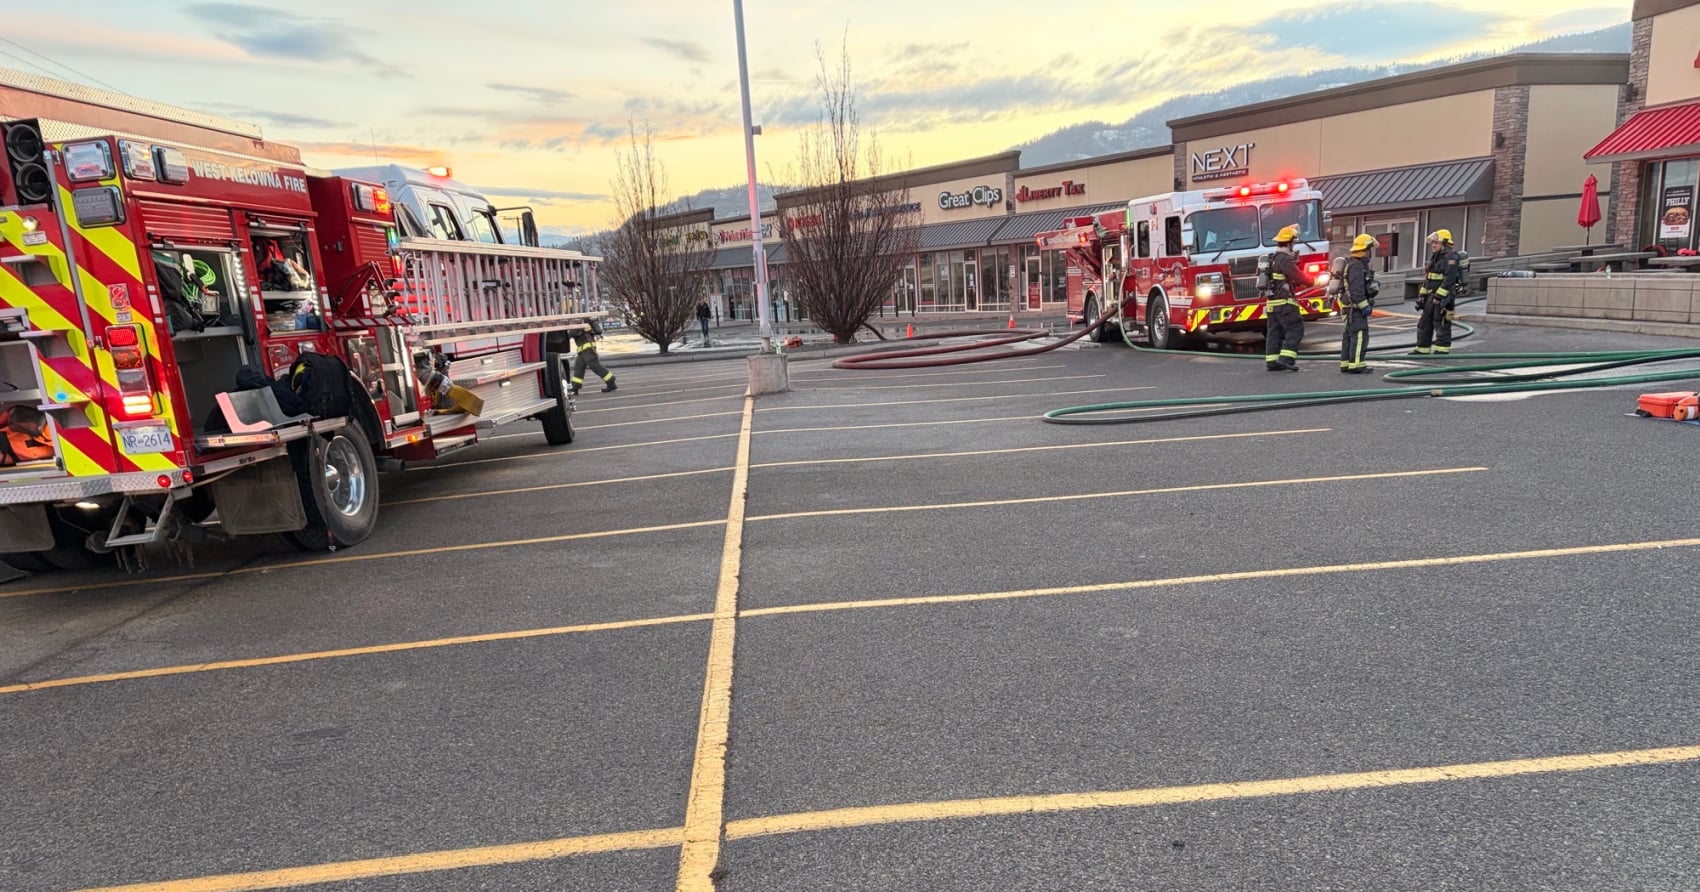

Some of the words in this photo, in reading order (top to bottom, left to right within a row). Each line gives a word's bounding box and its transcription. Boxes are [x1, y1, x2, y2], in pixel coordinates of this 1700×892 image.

[1191, 143, 1255, 173] NEXT
[191, 160, 227, 180] WEST
[229, 166, 283, 189] KELOWNA
[283, 175, 307, 193] FIRE
[938, 192, 971, 210] Great
[972, 186, 1002, 208] Clips
[1665, 197, 1690, 207] PHILLY
[122, 435, 138, 448] NR
[142, 432, 170, 447] 2614
